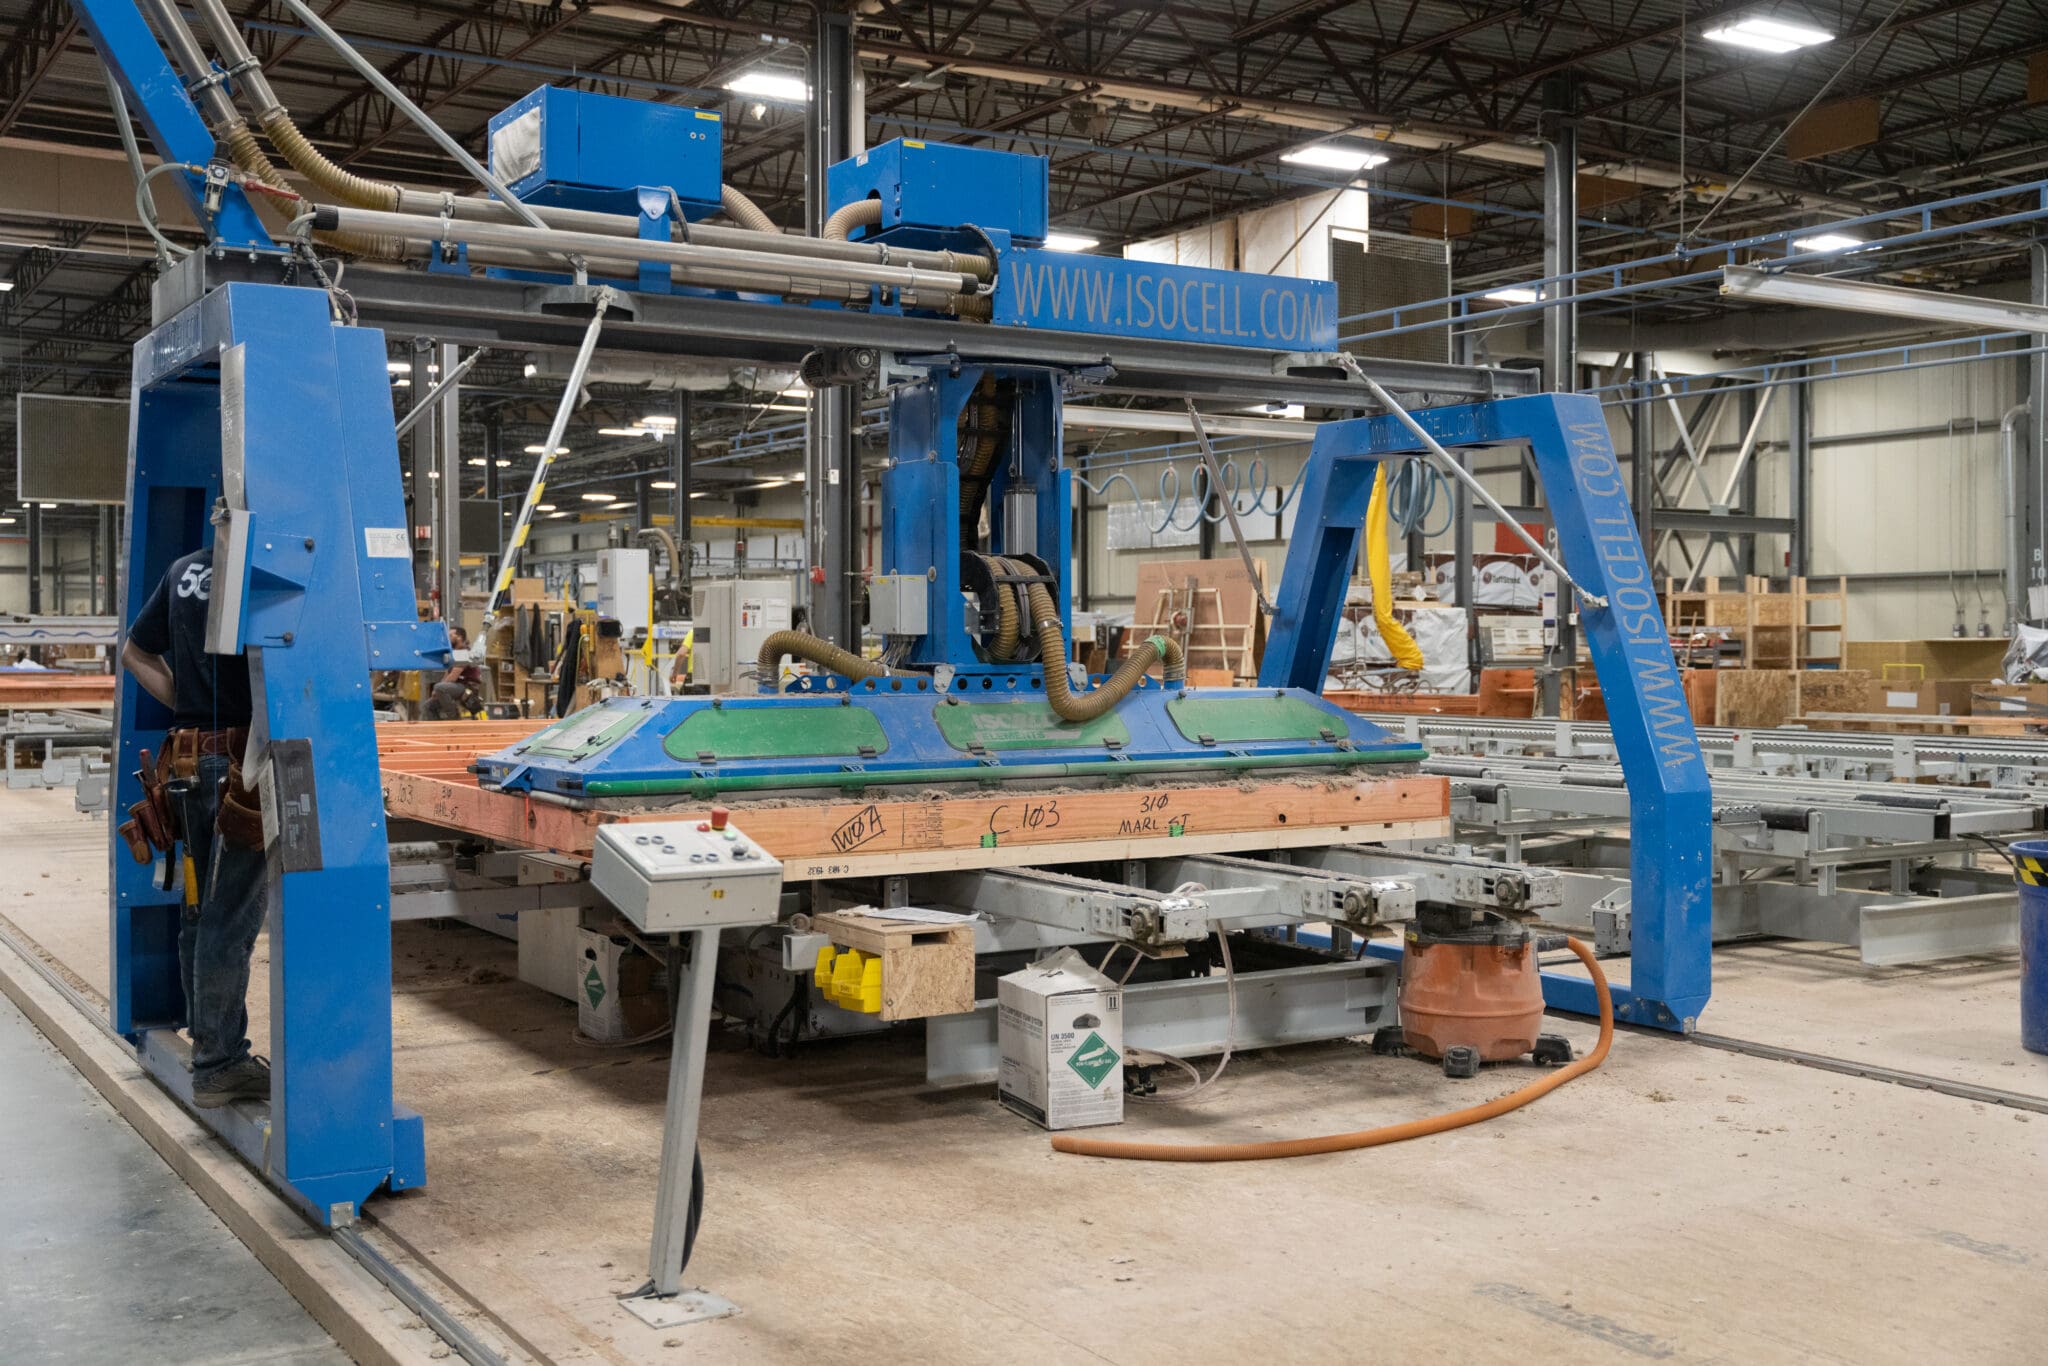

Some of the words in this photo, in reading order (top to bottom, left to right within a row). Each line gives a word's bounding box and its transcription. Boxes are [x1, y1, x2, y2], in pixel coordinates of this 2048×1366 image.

[1011, 261, 1327, 344] WWW.ISOCELL.COM
[1568, 422, 1697, 769] WWW.ISOCELL.COM
[1140, 793, 1168, 813] 310
